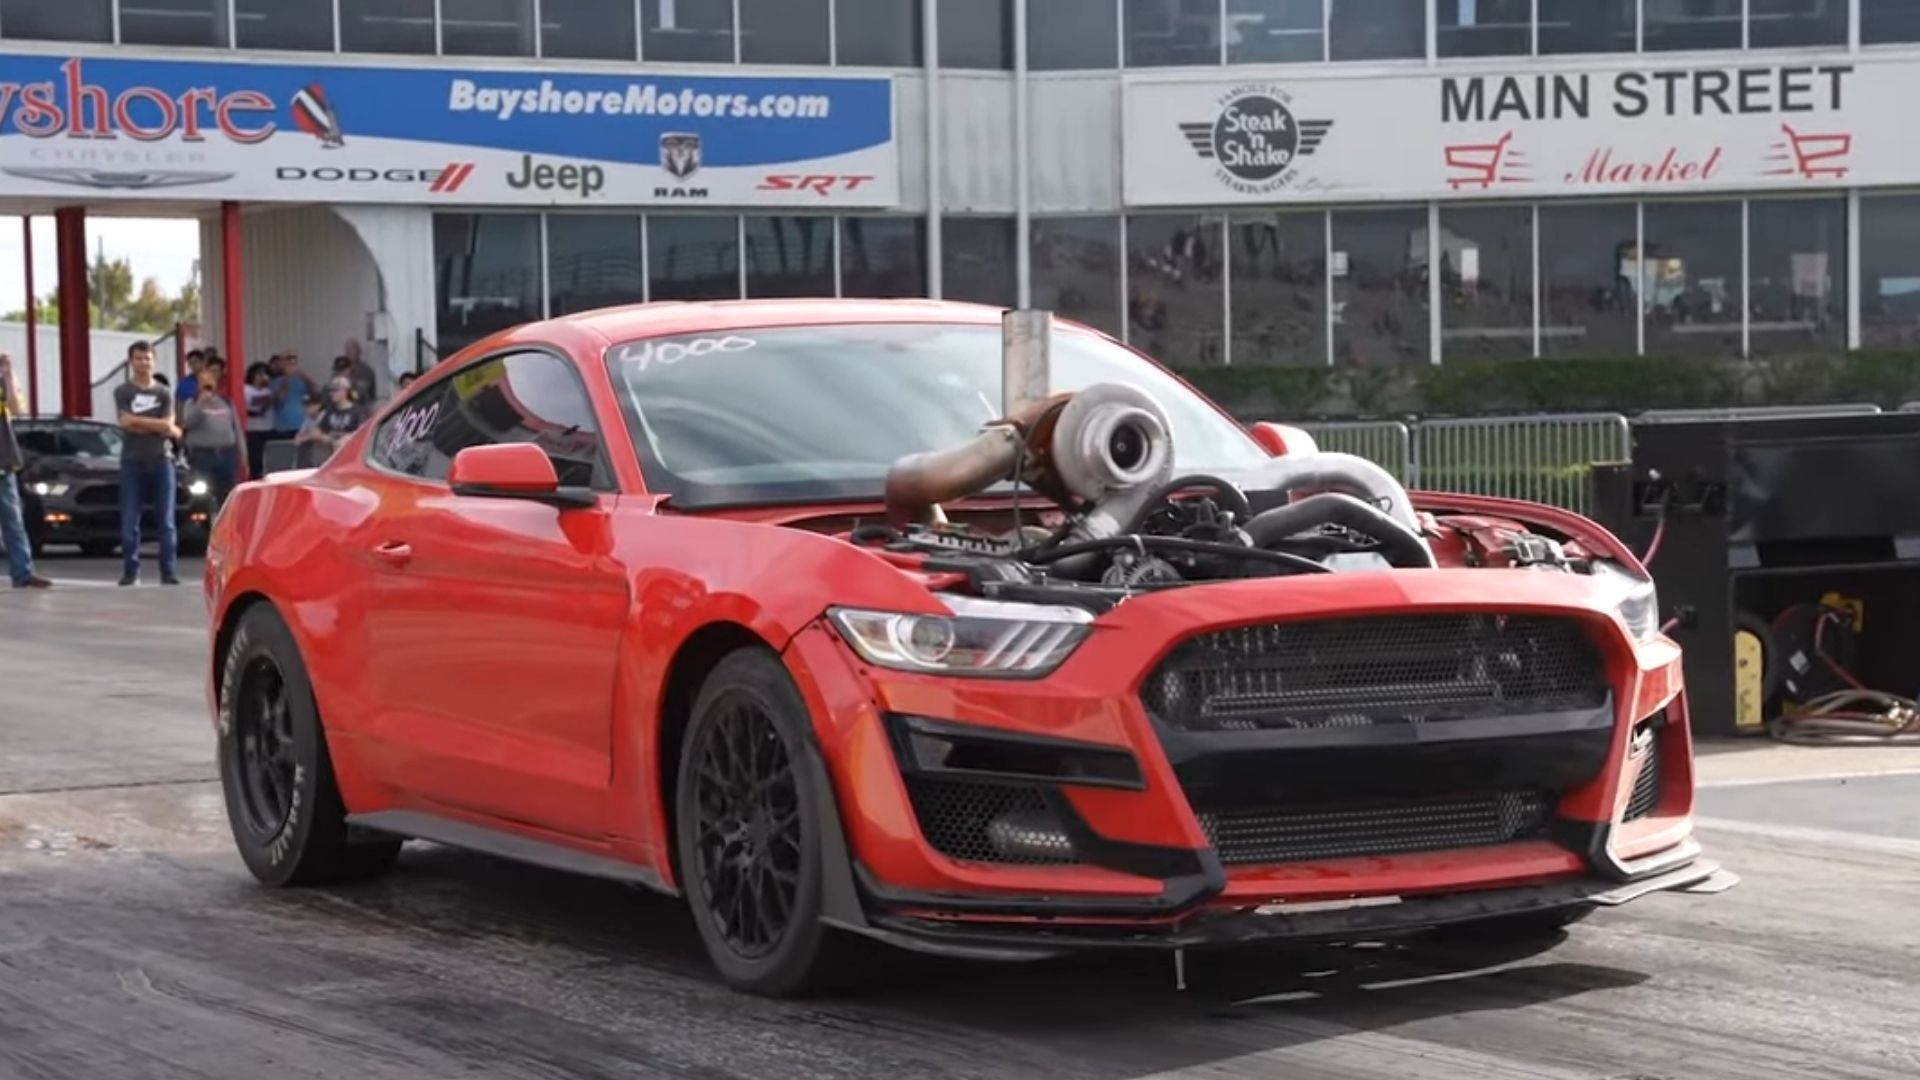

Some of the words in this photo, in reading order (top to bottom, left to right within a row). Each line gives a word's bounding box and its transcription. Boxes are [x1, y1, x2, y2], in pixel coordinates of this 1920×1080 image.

[449, 79, 829, 120] BayshoreMotors.com
[1441, 73, 1590, 122] MAIN
[1612, 66, 1854, 118] STREET
[1224, 106, 1287, 133] Steak
[1223, 139, 1290, 167] Shake
[1563, 146, 1723, 184] Market
[276, 166, 446, 183] DODGE
[506, 154, 605, 198] Jeep
[755, 174, 875, 196] SRT
[653, 187, 709, 198] RAM
[619, 336, 757, 371] 4000
